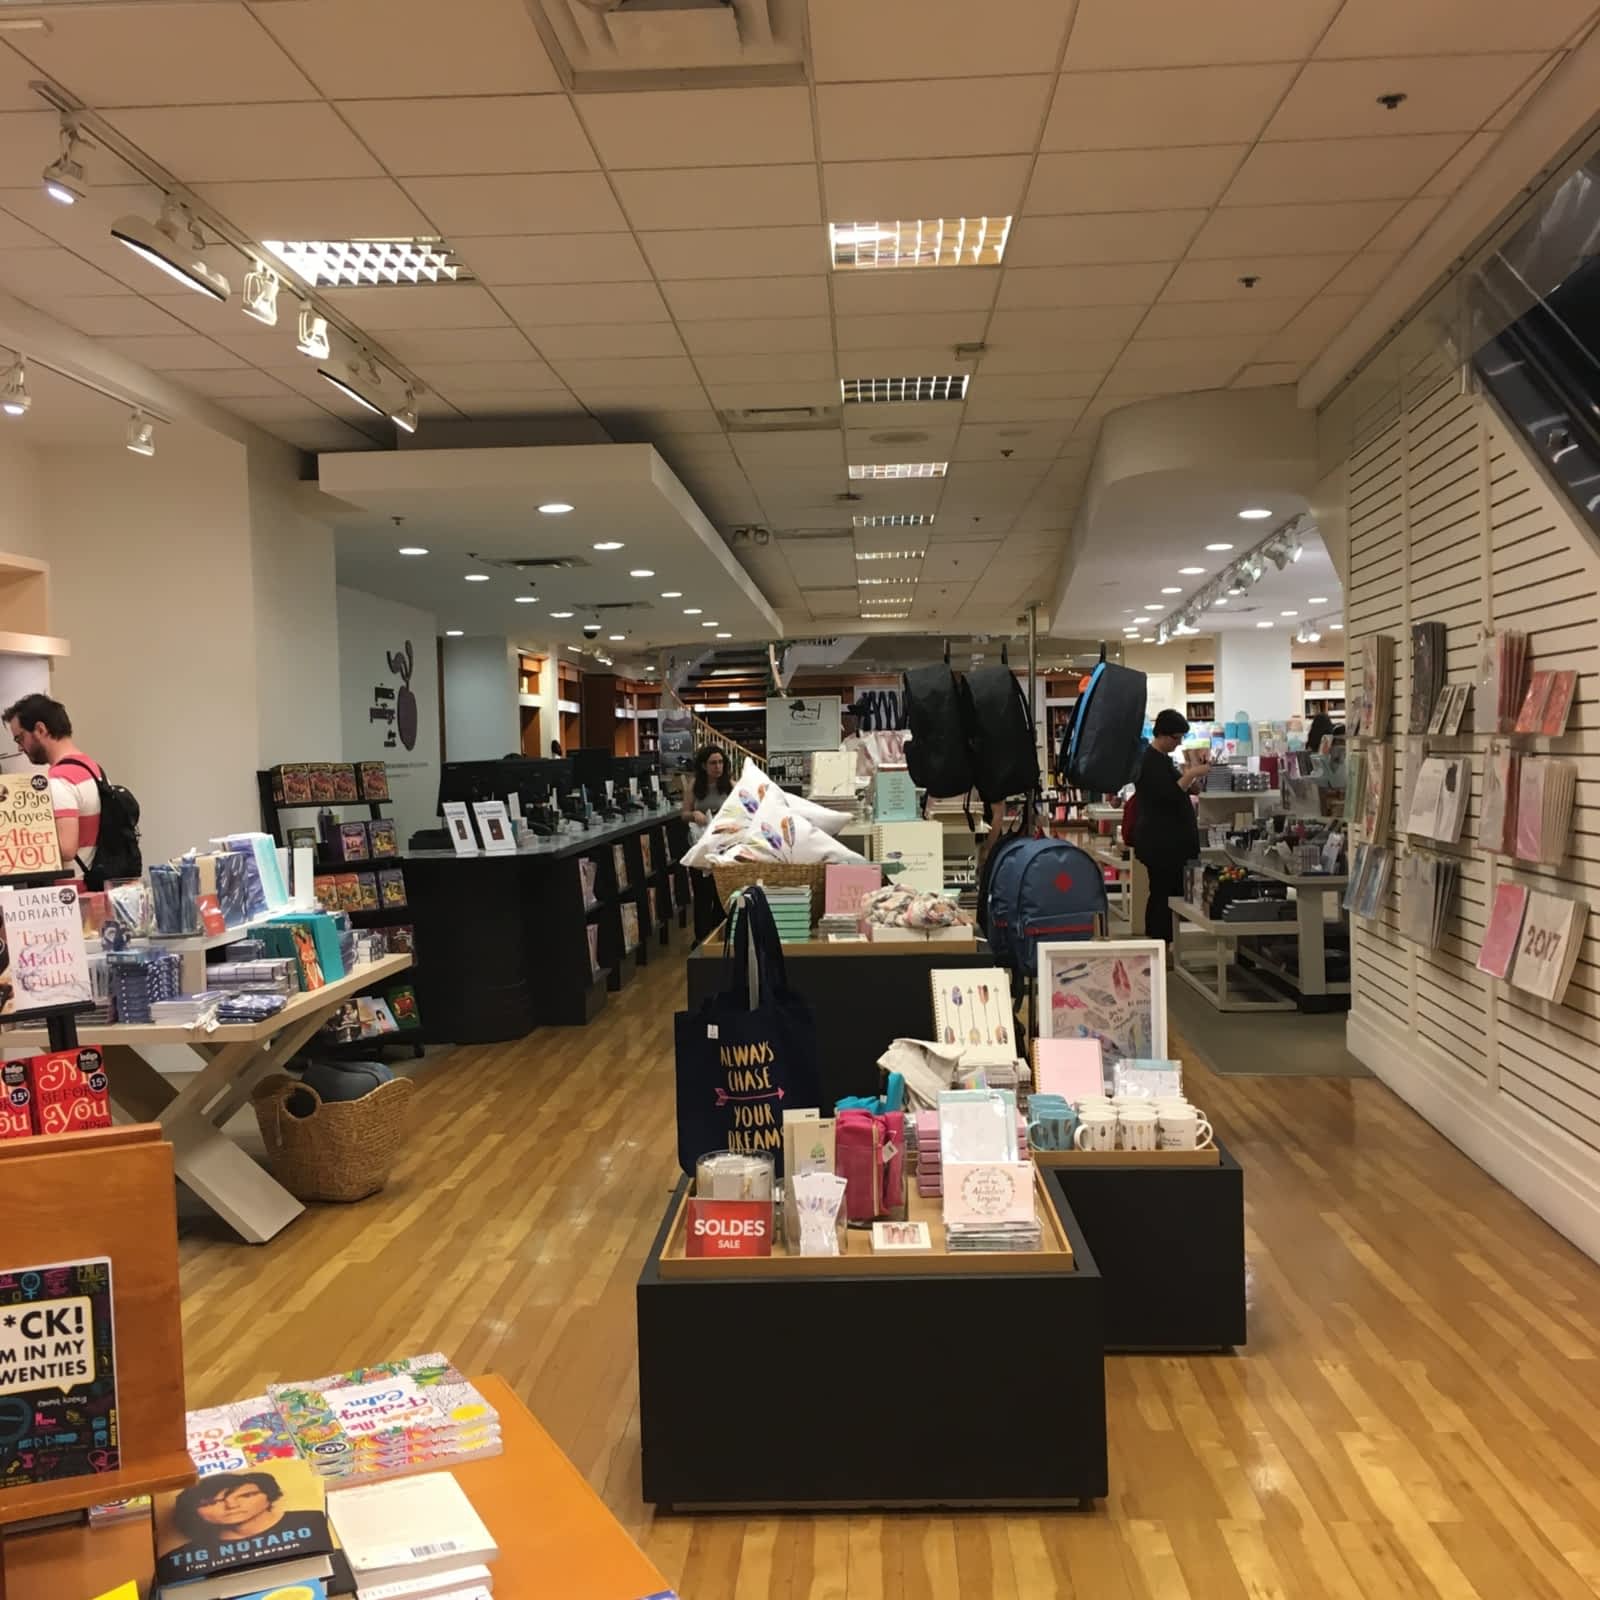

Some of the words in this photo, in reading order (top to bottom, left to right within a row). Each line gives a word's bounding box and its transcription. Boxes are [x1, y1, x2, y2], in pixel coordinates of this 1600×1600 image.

[13, 790, 50, 809] Jojo
[0, 808, 53, 827] Moyes
[0, 828, 53, 848] After
[18, 892, 58, 907] LIANE
[5, 906, 73, 922] MORIARTY
[1524, 925, 1562, 962] 2017
[720, 1041, 775, 1066] ALWAYS
[728, 1066, 772, 1092] CHASE
[734, 1103, 775, 1127] YOUR
[728, 1127, 784, 1153] DREAM
[694, 1219, 766, 1237] SOLDES
[717, 1240, 742, 1249] SALE
[24, 1343, 46, 1361] IN
[54, 1339, 85, 1357] MY
[0, 1359, 87, 1386] WENTIES
[170, 1550, 209, 1567] TIG
[220, 1527, 312, 1557] NOTARO
